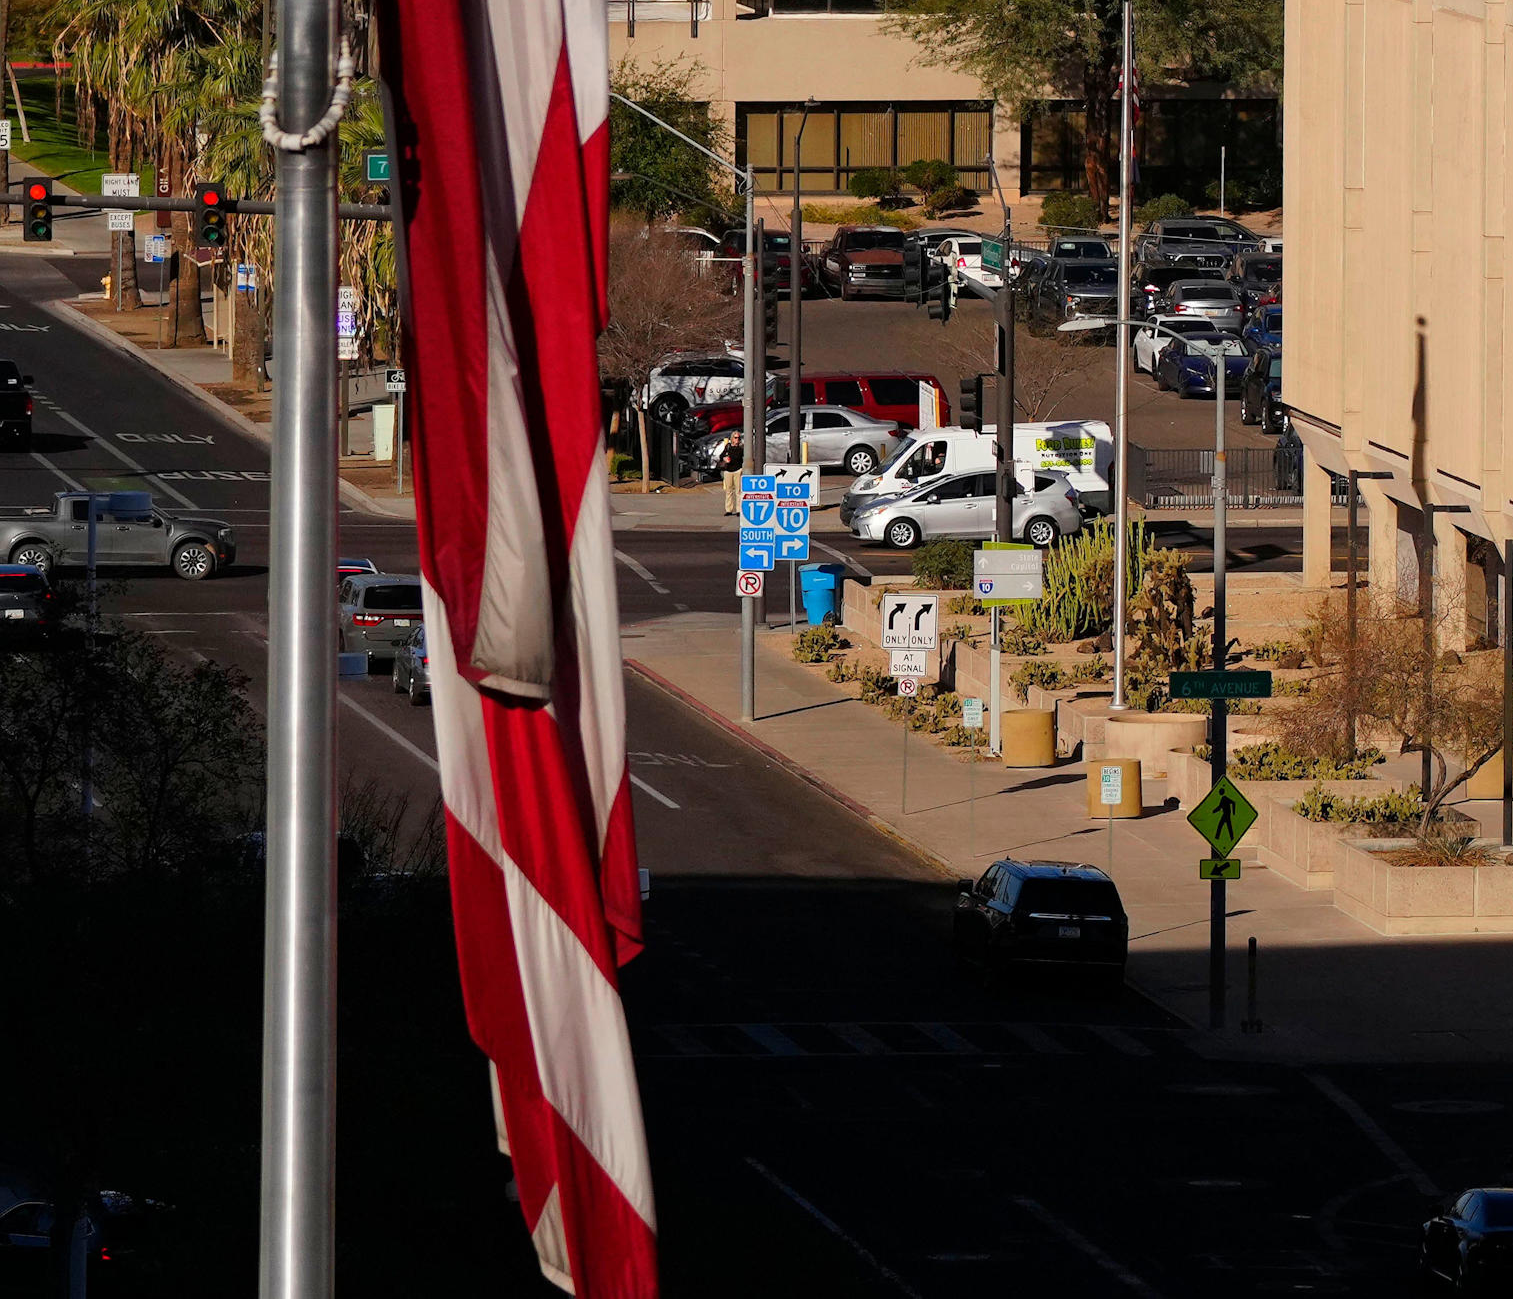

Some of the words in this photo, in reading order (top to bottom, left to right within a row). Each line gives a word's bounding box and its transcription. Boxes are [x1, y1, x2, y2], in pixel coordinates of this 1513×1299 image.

[115, 432, 216, 445] ONLY
[749, 478, 768, 490] TO
[784, 485, 801, 496] TO
[748, 501, 770, 521] 17
[782, 508, 805, 528] 10
[742, 530, 773, 542] SOUTH
[1018, 554, 1039, 562] State
[1010, 562, 1039, 572] Capitol
[981, 583, 991, 591] 10
[885, 635, 907, 644] ONLY
[911, 636, 934, 645] ONLY
[903, 654, 914, 662] AT
[893, 664, 923, 673] SIGNAL
[1181, 681, 1206, 696] 6TH
[1210, 681, 1260, 694] AVENUE
